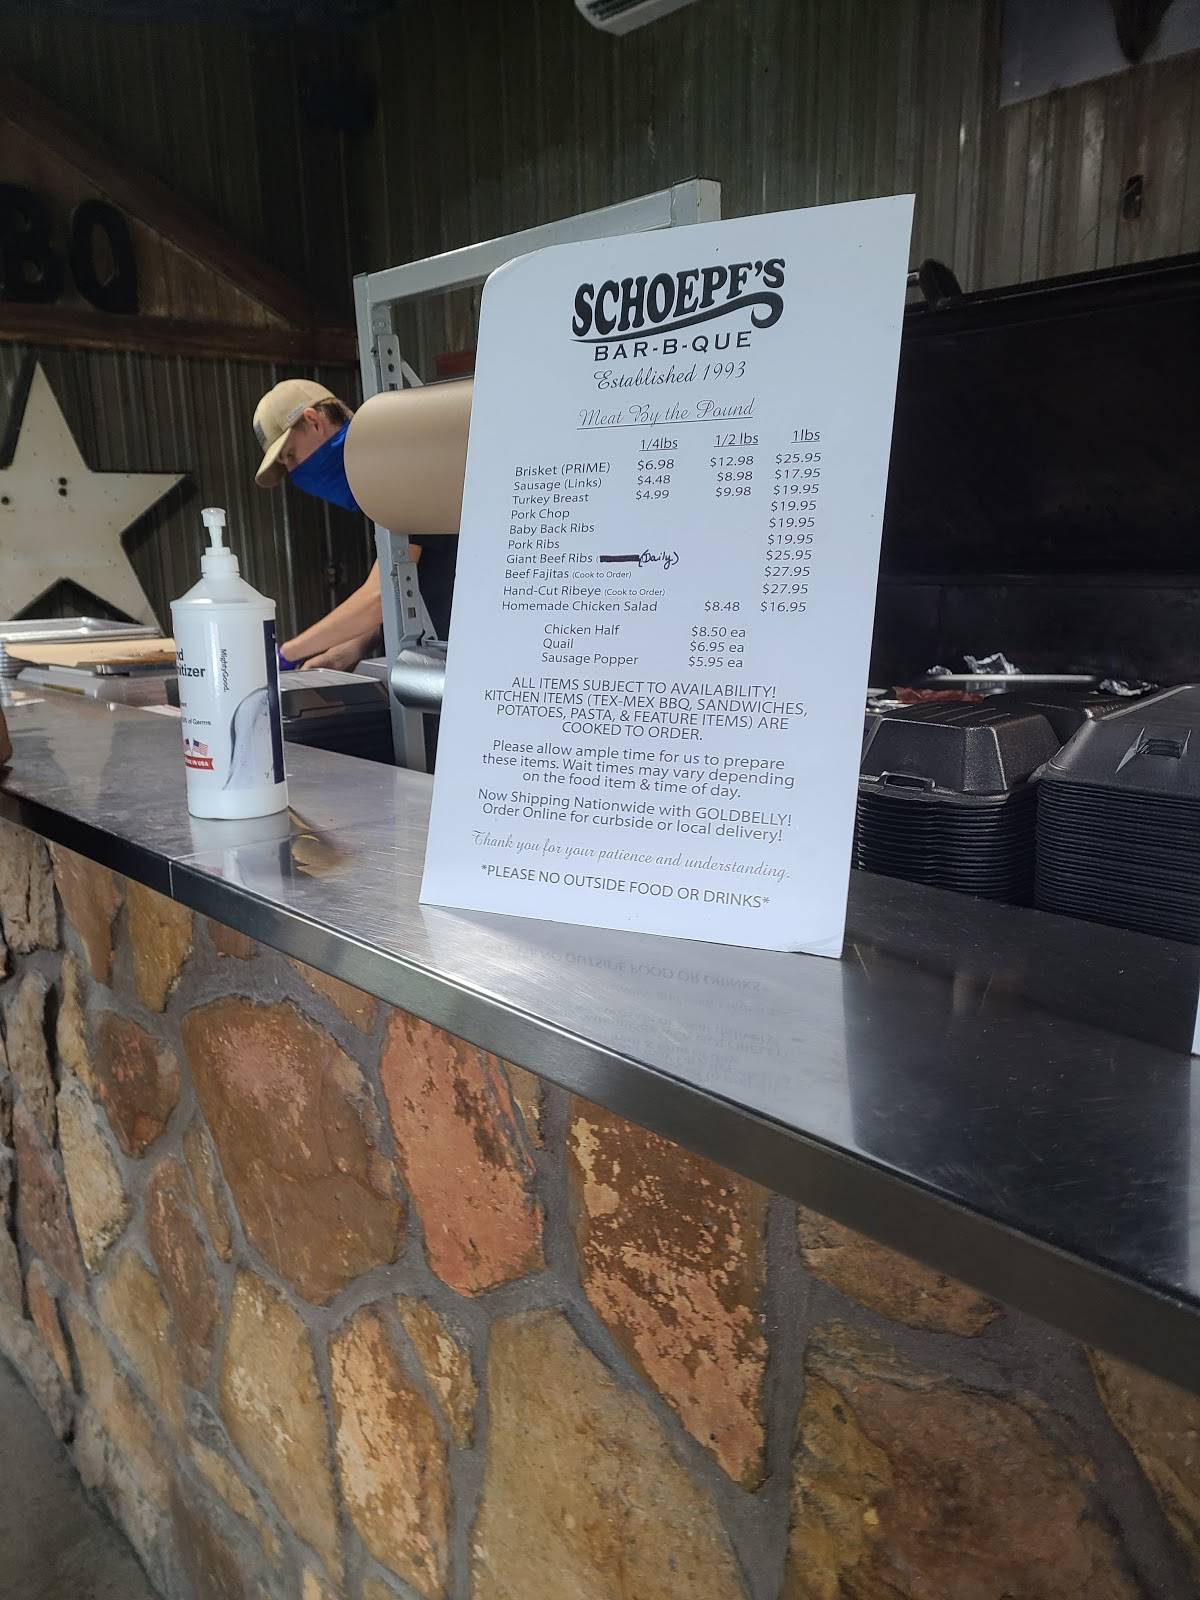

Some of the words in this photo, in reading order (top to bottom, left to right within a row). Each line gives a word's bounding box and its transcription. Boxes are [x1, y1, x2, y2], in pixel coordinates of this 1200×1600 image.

[571, 258, 786, 337] SCHOEPF'S
[594, 331, 752, 362] BAR-B-QUE
[594, 363, 697, 390] Established
[703, 360, 746, 381] 1993
[579, 408, 624, 427] Meat
[629, 404, 661, 428] By
[664, 401, 690, 421] the
[696, 398, 756, 419] Pound
[714, 434, 737, 446] 1/2
[740, 432, 759, 444] lbs
[792, 428, 820, 442] 1lbs
[640, 438, 678, 451] 1/4lbs
[710, 455, 754, 468] $12.98
[775, 452, 821, 465] $25.95
[515, 465, 558, 477] Brisket
[561, 461, 610, 476] (PRIME)
[637, 459, 674, 472] $6.98
[637, 474, 671, 486] $4.48
[717, 471, 753, 483] $8.98
[774, 468, 821, 481] $17.95
[513, 481, 561, 492] Sausage
[564, 477, 602, 490] (Links)
[773, 483, 819, 496] $19.95
[635, 489, 671, 501] $4.99
[715, 486, 751, 498] $9.98
[512, 494, 550, 506] Turkey
[553, 493, 589, 503] Breast
[771, 500, 816, 513] $19.95
[511, 508, 536, 520] Pork
[539, 508, 570, 520] Chop
[509, 524, 538, 536] Baby
[540, 523, 567, 534] Back
[570, 522, 595, 533] Ribs
[769, 516, 815, 529] $19.95
[508, 539, 533, 550] Pork
[536, 538, 560, 549] Ribs
[767, 533, 814, 546] $19.95
[506, 554, 537, 564] Giant
[540, 553, 567, 564] Beef
[568, 552, 593, 563] Ribs
[639, 549, 680, 570] (Daily)
[766, 549, 812, 561] $25.95
[505, 568, 531, 579] Beef
[533, 569, 569, 581] Fajitas
[572, 571, 595, 579] (Cook
[606, 571, 632, 579] Order)
[764, 565, 811, 578] $27.95
[503, 585, 558, 596] Hand-Cut
[561, 585, 601, 598] Ribeye
[604, 588, 627, 597] (Cook
[639, 588, 665, 597] Order)
[761, 582, 808, 595] $27.95
[502, 600, 569, 611] Homemade
[572, 600, 620, 611] Chicken
[623, 601, 658, 612] Salad
[704, 600, 741, 612] $8.48
[760, 600, 807, 613] $16.95
[544, 623, 591, 635] Chicken
[595, 624, 621, 635] Half
[691, 625, 727, 637] $8.50
[730, 629, 746, 638] ea
[543, 638, 574, 649] Quail
[689, 640, 725, 652] $6.95
[729, 644, 744, 653] ea
[541, 652, 591, 666] Sausage
[593, 653, 639, 667] Popper
[688, 655, 724, 668] $5.95
[727, 659, 743, 668] ea
[511, 677, 536, 689] ALL
[539, 677, 579, 690] ITEMS
[582, 679, 645, 693] SUBJECT
[646, 681, 667, 694] TO
[670, 682, 776, 698] AVAILABILITY!
[484, 689, 540, 703] KITCHEN
[543, 692, 583, 705] ITEMS
[587, 694, 655, 708] (TEX-MEX
[659, 697, 692, 712] BBQ,
[697, 698, 807, 717] SANDWICHES,
[497, 704, 566, 720] POTATOES,
[570, 707, 616, 722] PASTA,
[619, 710, 630, 722] &
[634, 711, 698, 725] FEATURE
[702, 714, 753, 730] ITEMS)
[757, 716, 789, 730] ARE
[562, 721, 622, 736] COOKED
[624, 724, 644, 737] TO
[648, 726, 703, 741] ORDER.
[493, 739, 533, 753] Please
[536, 742, 572, 756] allow
[575, 746, 619, 761] ample
[622, 748, 655, 761] time
[659, 749, 680, 763] for
[683, 754, 700, 764] us
[704, 754, 719, 766] to
[724, 757, 785, 771] prepare
[481, 752, 517, 766] these
[520, 755, 559, 769] items.
[563, 758, 593, 772] Wait
[596, 761, 634, 775] times
[638, 767, 669, 780] may
[673, 769, 705, 783] vary
[709, 768, 795, 789] depending
[522, 772, 540, 782] on
[543, 771, 565, 784] the
[569, 772, 601, 787] food
[604, 775, 636, 789] item
[640, 778, 651, 791] &
[654, 780, 687, 794] time
[691, 782, 709, 795] of
[710, 784, 741, 800] day.
[478, 788, 508, 801] Now
[510, 791, 570, 810] Shipping
[574, 796, 655, 815] Nationwide
[659, 804, 691, 818] with
[696, 807, 792, 827] GOLDBELLY!
[483, 803, 520, 816] Order
[523, 806, 567, 821] Online
[570, 810, 589, 823] for
[592, 814, 653, 829] curbside
[657, 821, 673, 831] or
[676, 819, 711, 835] local
[715, 824, 782, 844] delivery!
[472, 830, 513, 848] Thank
[516, 842, 541, 852] you
[542, 838, 563, 857] for
[565, 847, 596, 858] your
[597, 849, 654, 863] patience
[655, 852, 682, 866] and
[685, 855, 790, 881] understanding.
[539, 870, 560, 884] NO
[563, 874, 626, 892] OUTSIDE
[629, 881, 673, 897] FOOD
[677, 887, 699, 901] OR
